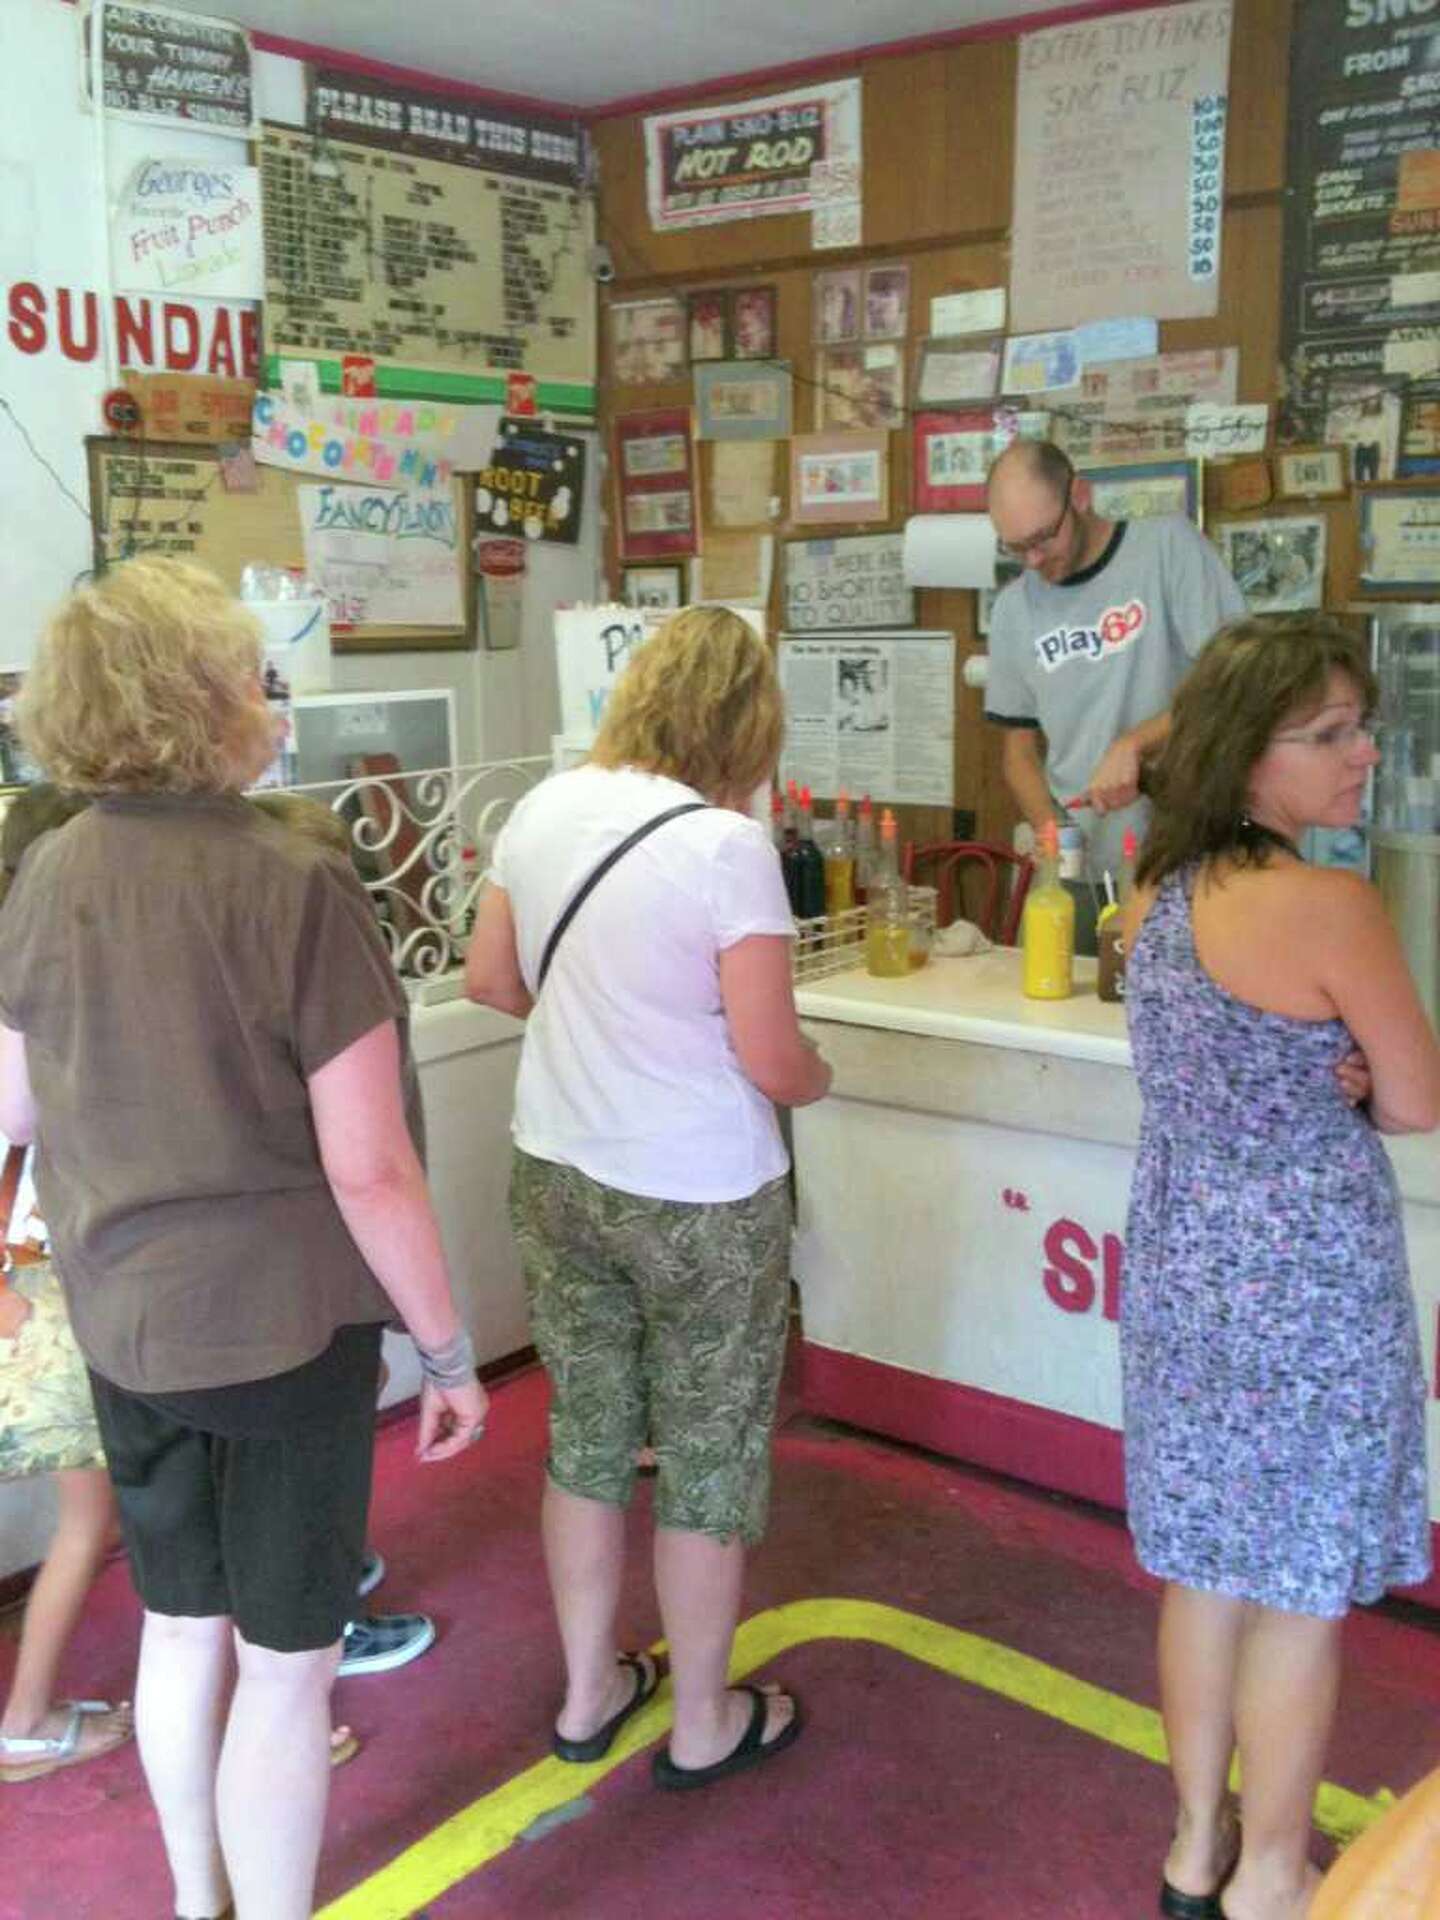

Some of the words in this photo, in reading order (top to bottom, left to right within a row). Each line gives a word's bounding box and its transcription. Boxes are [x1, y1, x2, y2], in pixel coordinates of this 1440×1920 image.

[106, 30, 157, 58] YOUR
[1344, 46, 1409, 77] FROM
[316, 87, 402, 132] PLEASE
[474, 118, 528, 155] THIS
[674, 146, 739, 182] HOT
[743, 136, 815, 169] ROD
[186, 199, 252, 258] Punch
[479, 466, 542, 496] ROOT
[315, 486, 397, 534] FANCY
